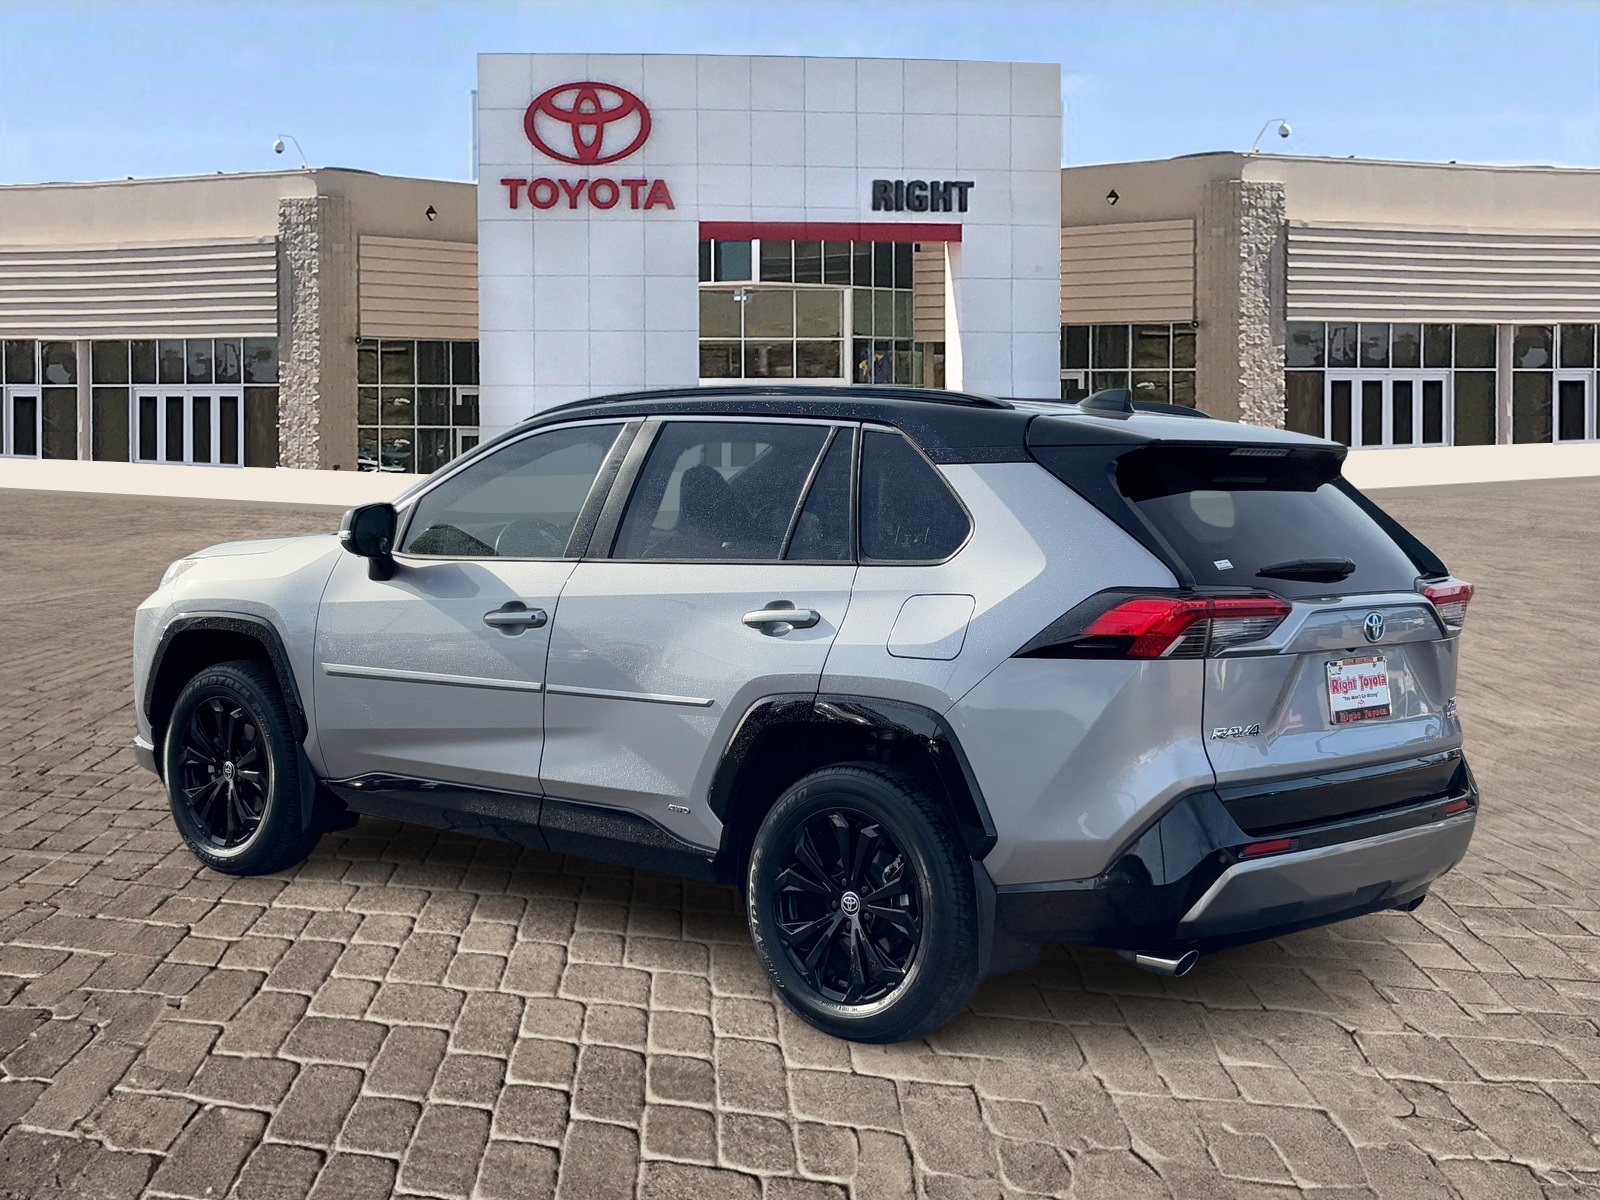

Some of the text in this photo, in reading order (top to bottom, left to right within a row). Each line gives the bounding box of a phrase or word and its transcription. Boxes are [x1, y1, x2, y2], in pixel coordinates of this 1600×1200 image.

[500, 178, 675, 209] TOYOTA
[872, 180, 975, 212] RIGHT
[1330, 672, 1387, 695] Right Toyota
[1340, 708, 1387, 722] Right Toyota
[1210, 723, 1261, 740] RAV4
